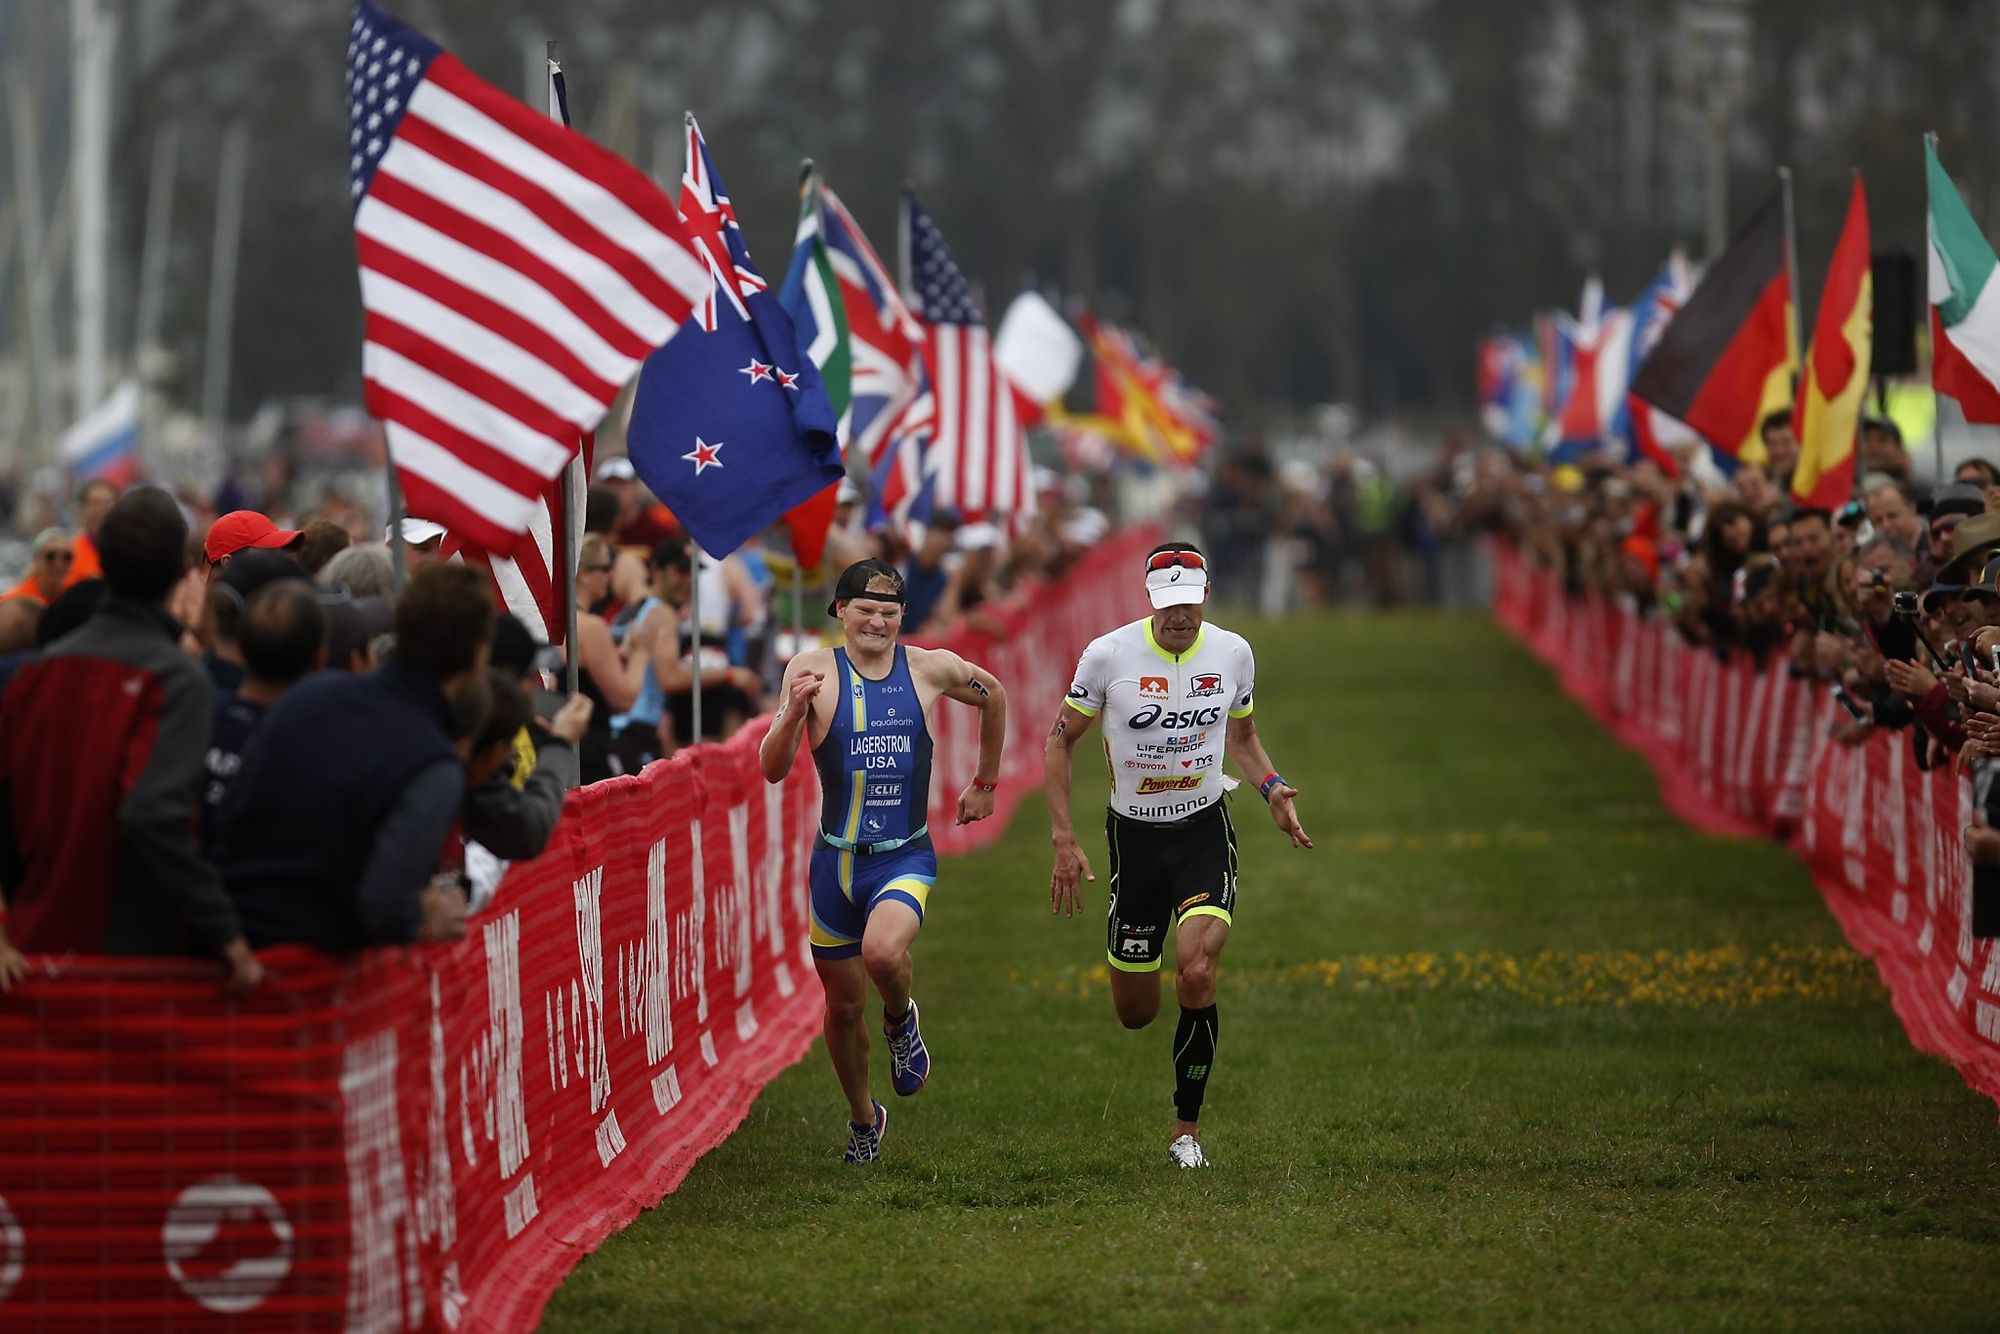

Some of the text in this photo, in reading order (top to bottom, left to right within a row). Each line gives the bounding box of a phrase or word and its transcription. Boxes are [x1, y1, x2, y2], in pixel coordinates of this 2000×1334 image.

[1139, 693, 1169, 701] NATHAN
[870, 718, 914, 728] equalearth
[850, 735, 911, 755] LAGERSTROM
[1136, 741, 1206, 754] LIFEPROOF
[866, 755, 897, 769] USA
[1136, 762, 1167, 770] TOYOTA
[1195, 754, 1213, 766] TYR
[1140, 775, 1202, 791] PowerBar
[874, 785, 900, 795] CLIF
[1129, 796, 1208, 817] SHIMANO
